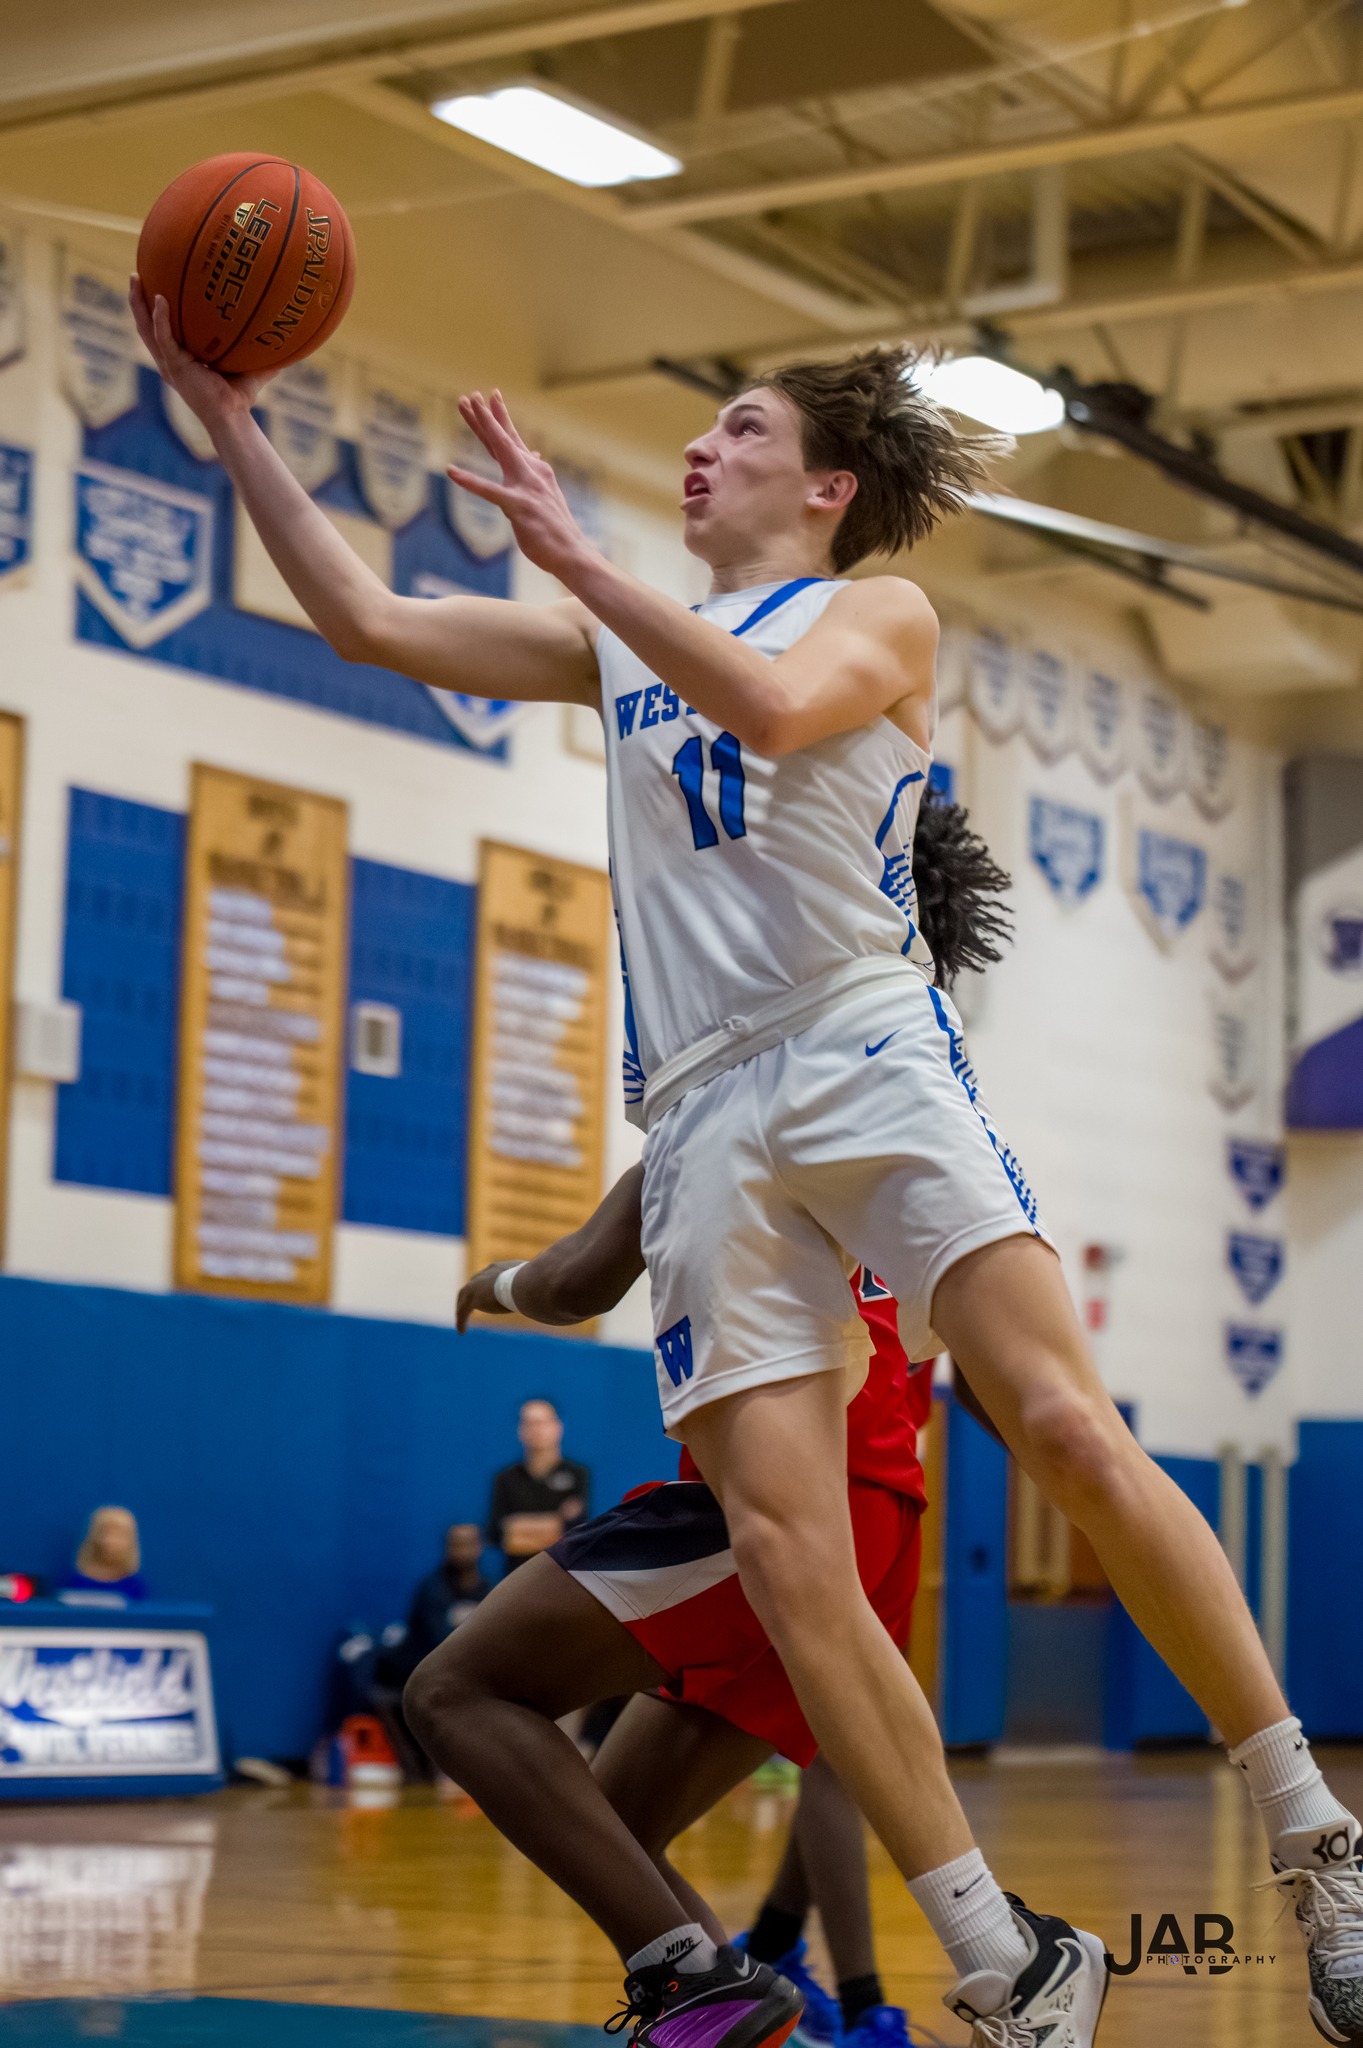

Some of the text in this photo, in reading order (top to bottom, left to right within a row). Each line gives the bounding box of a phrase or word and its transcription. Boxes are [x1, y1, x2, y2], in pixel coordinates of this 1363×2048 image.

[216, 198, 281, 321] LEGACY
[254, 207, 332, 351] SPALDING
[615, 683, 697, 741] WES
[672, 731, 747, 851] 11
[655, 1314, 693, 1388] W
[665, 1936, 695, 1959] NIKE
